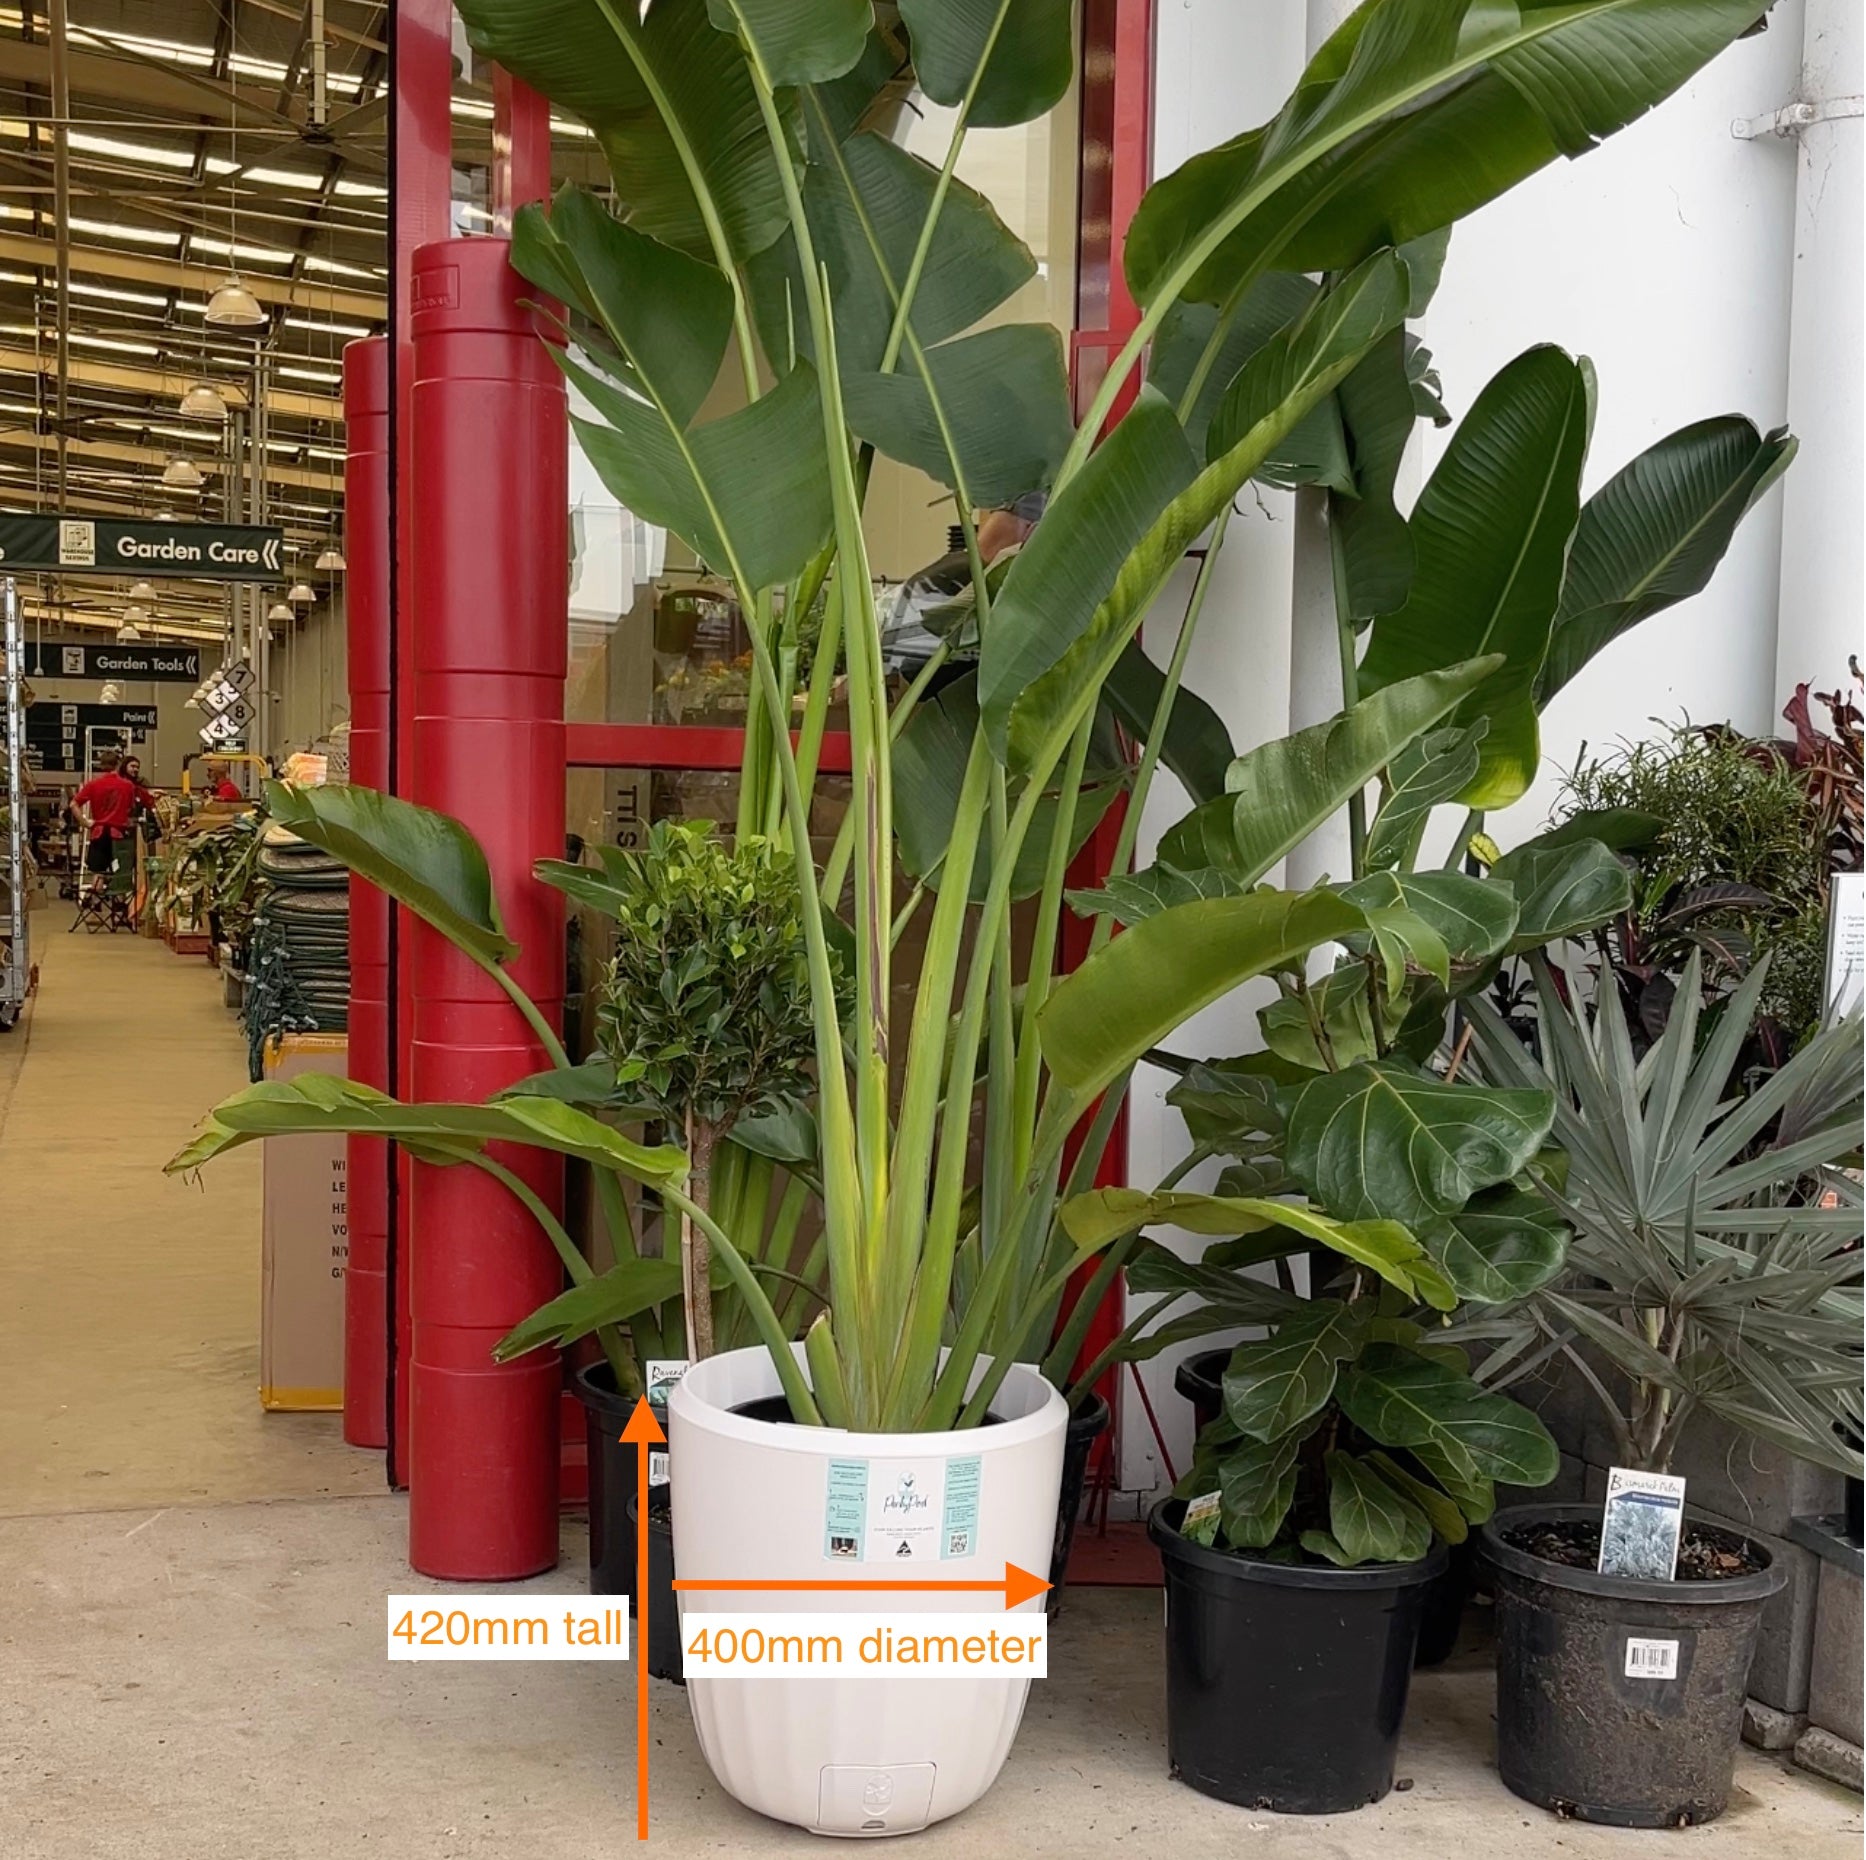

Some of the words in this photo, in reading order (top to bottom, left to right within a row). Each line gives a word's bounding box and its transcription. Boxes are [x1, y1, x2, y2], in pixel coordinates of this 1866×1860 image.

[117, 536, 201, 561] Garden
[208, 541, 259, 564] Care
[96, 655, 148, 671] Garden
[153, 657, 185, 672] Tools
[235, 670, 246, 684] 7
[215, 693, 224, 704] 3
[123, 711, 147, 722] Paint
[235, 705, 245, 719] 8
[214, 723, 223, 734] 4
[331, 1181, 346, 1192] LE
[332, 1203, 347, 1214] HE
[331, 1224, 347, 1235] VO
